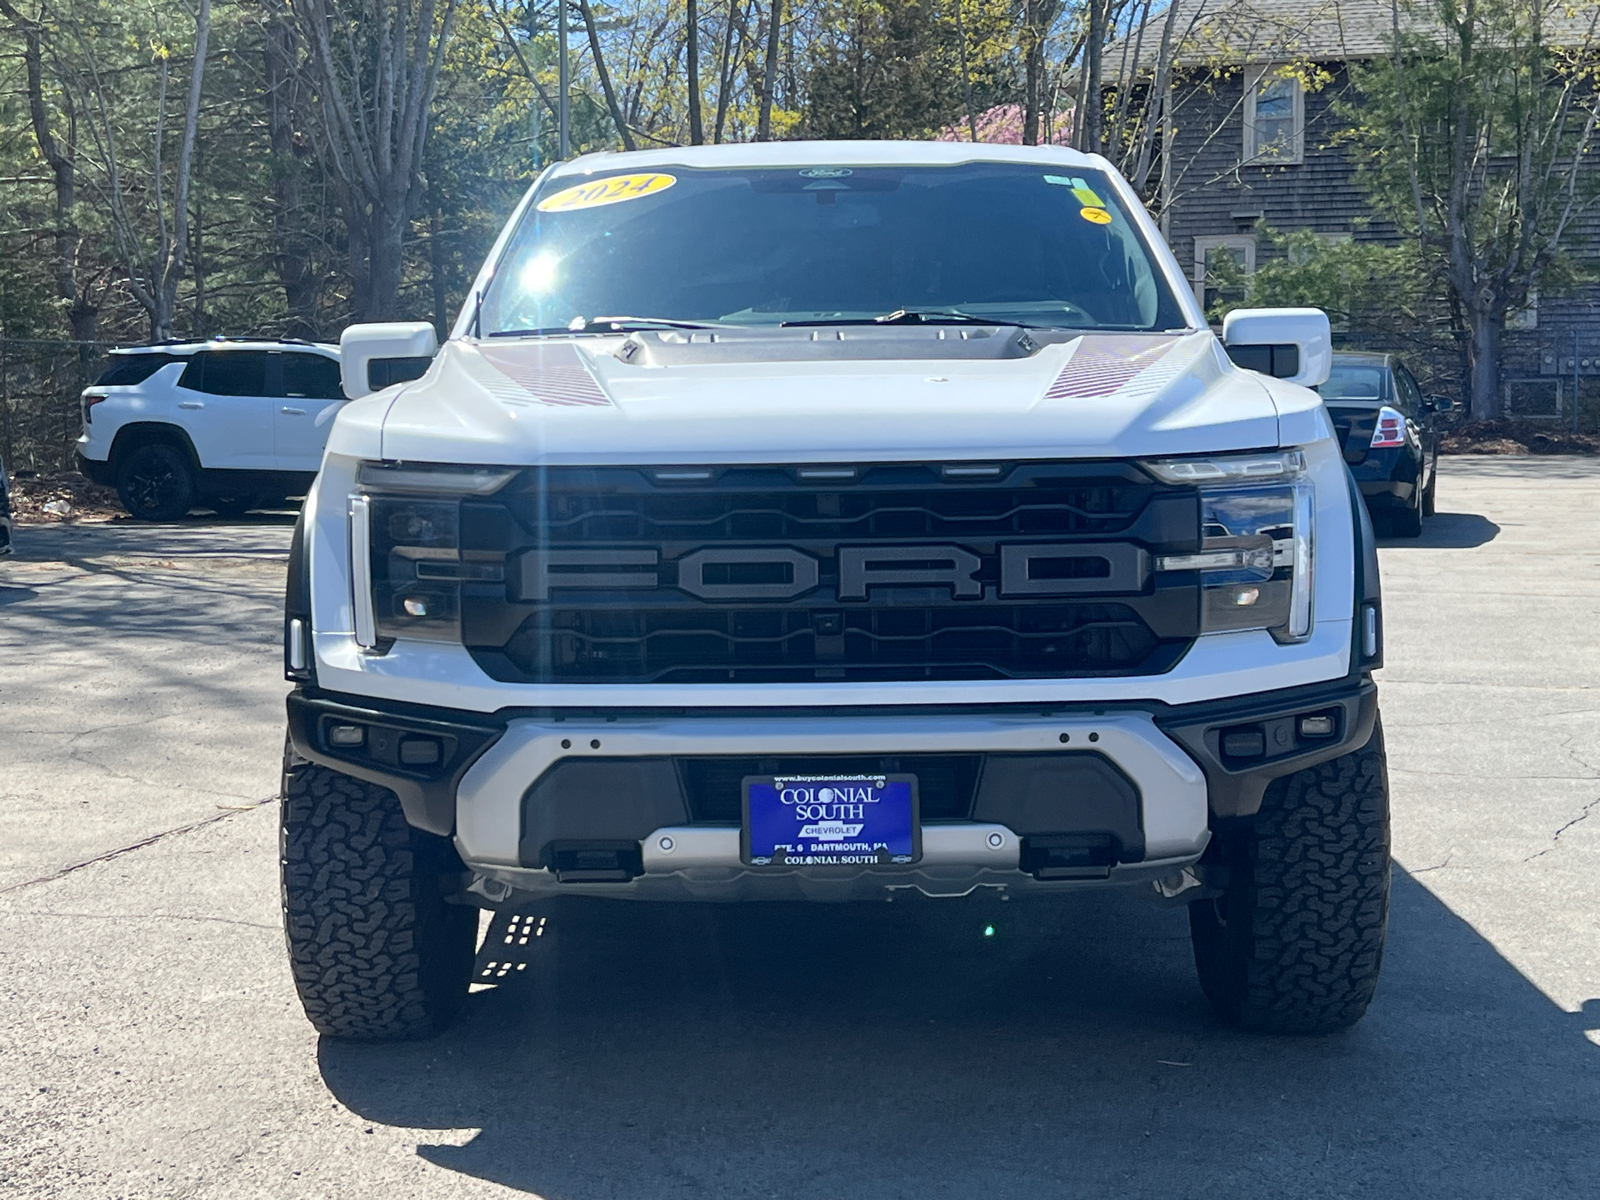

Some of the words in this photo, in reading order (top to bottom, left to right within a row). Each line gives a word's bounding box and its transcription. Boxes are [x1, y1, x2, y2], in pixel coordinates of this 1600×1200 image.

[561, 175, 658, 206] 2024
[518, 542, 1147, 600] FORD
[774, 774, 886, 782] www.buycolonialsouth.com
[780, 787, 880, 804] COLONIAL
[796, 804, 864, 820] SOUTH
[797, 843, 803, 852] 6
[810, 843, 871, 852] DARTMOUTH,
[784, 856, 840, 864] COLONIAL
[841, 855, 878, 864] SOUTH
